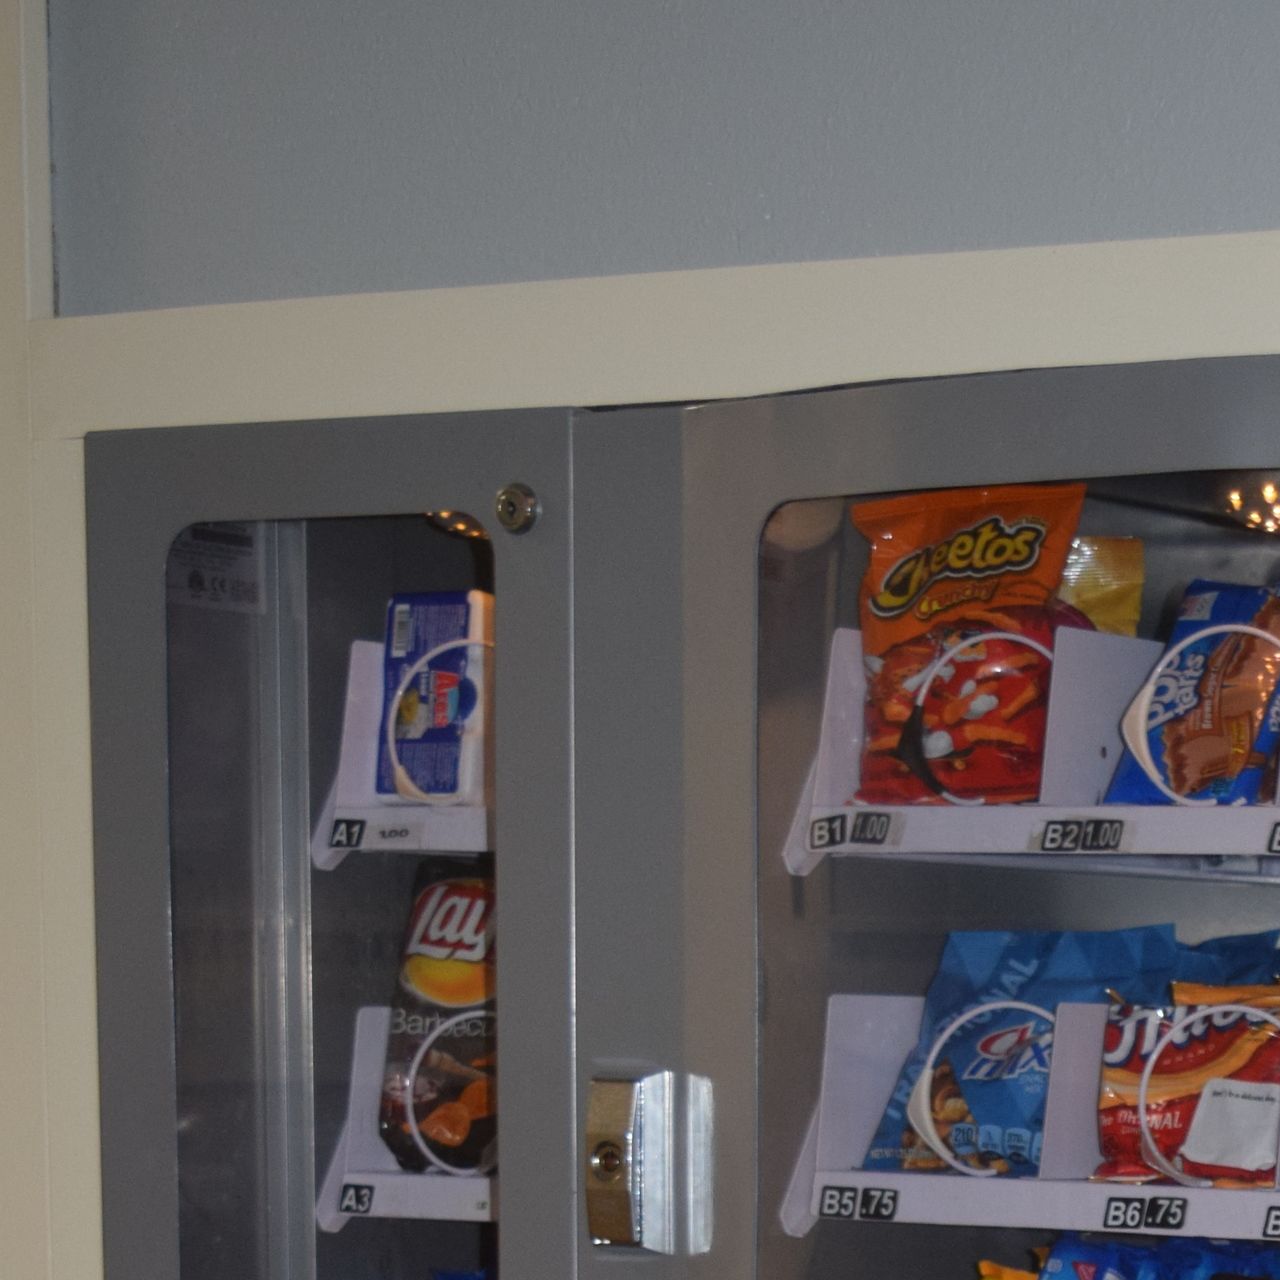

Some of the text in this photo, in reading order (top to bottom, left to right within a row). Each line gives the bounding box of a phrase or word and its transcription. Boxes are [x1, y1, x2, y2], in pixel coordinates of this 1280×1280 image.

[331, 822, 363, 848] A1
[812, 813, 890, 848] B1 1.00
[1043, 820, 1123, 849] B2 1.00
[407, 884, 492, 962] Lay
[340, 1186, 373, 1213] A3
[822, 1189, 897, 1217] B5 .75
[1107, 1199, 1184, 1227] B6 .75
